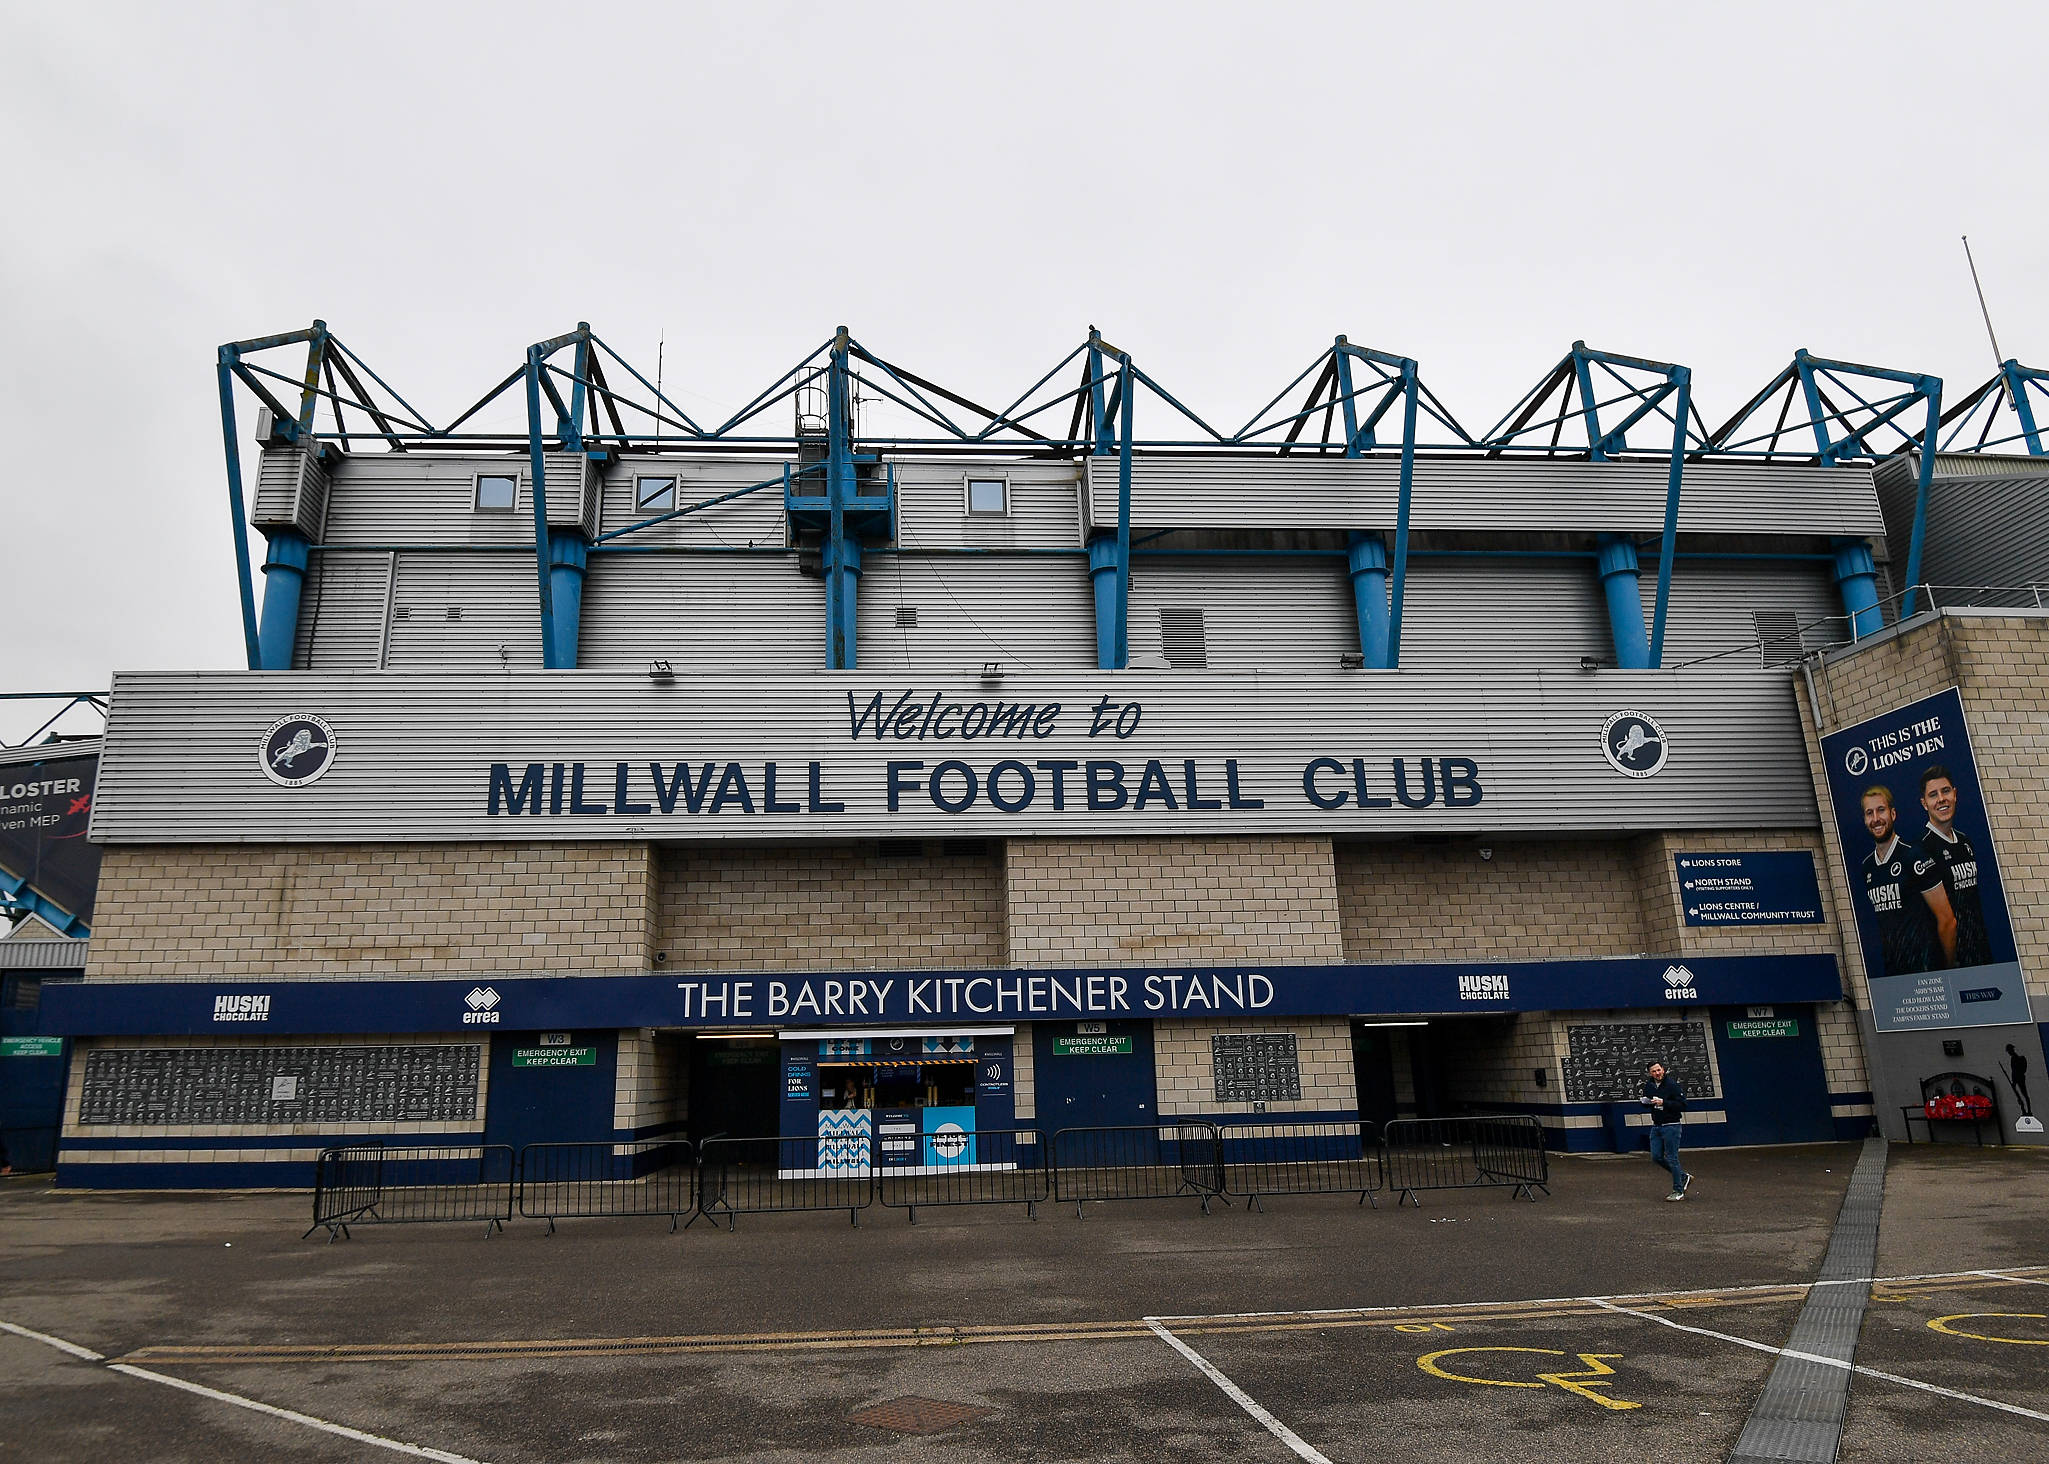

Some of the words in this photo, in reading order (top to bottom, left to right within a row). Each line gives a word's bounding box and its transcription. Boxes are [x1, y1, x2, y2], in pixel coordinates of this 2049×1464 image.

[848, 688, 1062, 740] Welcome
[1088, 694, 1142, 739] to
[260, 718, 288, 750] MILLWALL
[290, 714, 328, 730] FOOTBALL
[326, 729, 336, 749] CLUB
[1602, 714, 1620, 744] MILLWALL
[1620, 712, 1655, 726] FOOTBALL
[1656, 726, 1666, 744] CLUB
[1868, 732, 1898, 752] THIS
[1898, 728, 1911, 742] IS
[1912, 716, 1940, 737] THE
[1872, 746, 1914, 770] LIONS'
[1916, 735, 1944, 756] DEN
[0, 778, 80, 800] LOSTER
[486, 762, 844, 816] MILLWALL
[887, 758, 1265, 813] FOOTBALL
[1302, 757, 1483, 809] CLUB
[30, 814, 60, 828] MEP
[1741, 911, 1790, 919] COMMUNITY
[1458, 976, 1509, 991] HUSKI
[678, 982, 752, 1018] THE
[768, 980, 894, 1016] BARRY
[908, 976, 1131, 1014] KITCHENER
[1143, 974, 1274, 1010] STAND
[1665, 988, 1697, 999] errea
[1965, 992, 1979, 1001] THIS
[214, 996, 270, 1012] HUSKI
[213, 1012, 268, 1021] CHOCOLATE
[462, 1011, 500, 1024] errea
[1753, 1008, 1768, 1016] W7
[1084, 1024, 1100, 1032] W5
[1733, 1022, 1776, 1030] EMERGENCY
[548, 1035, 564, 1044] W3
